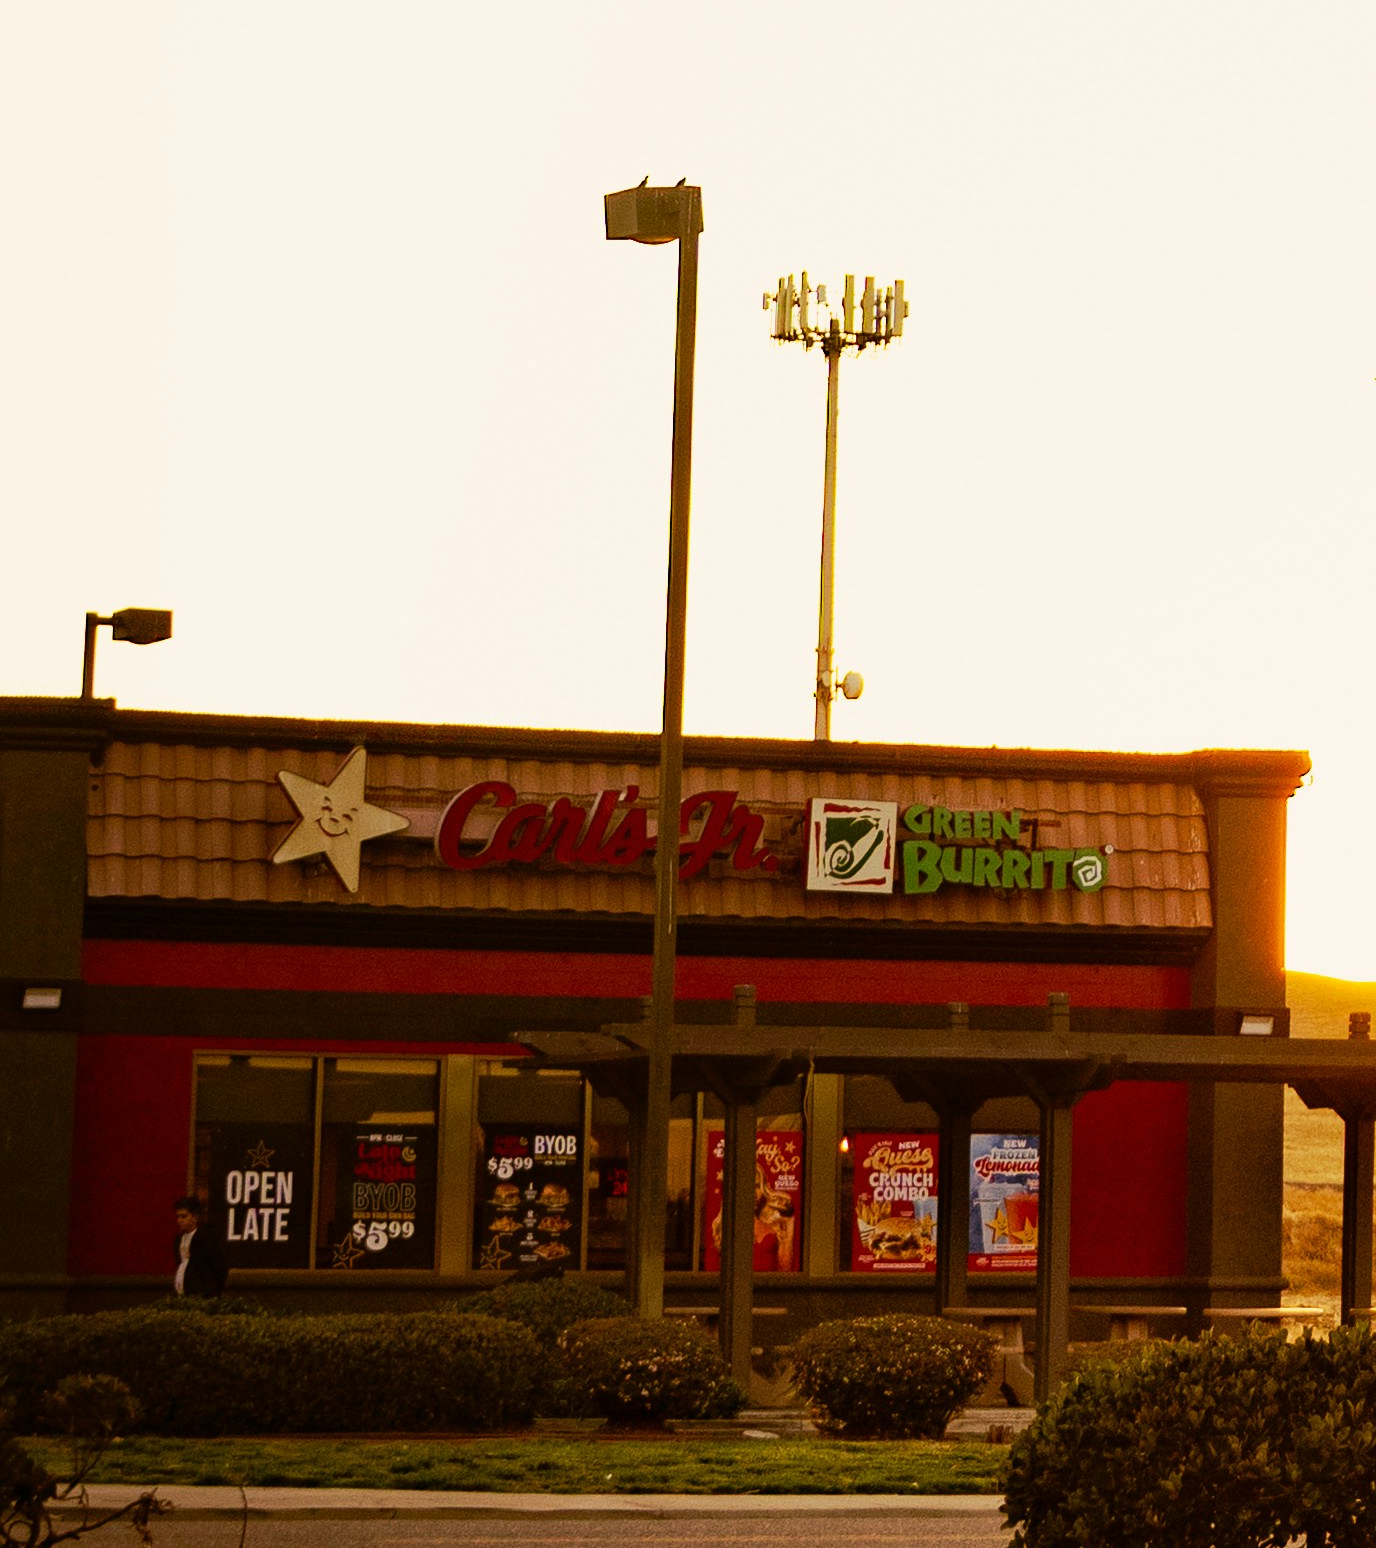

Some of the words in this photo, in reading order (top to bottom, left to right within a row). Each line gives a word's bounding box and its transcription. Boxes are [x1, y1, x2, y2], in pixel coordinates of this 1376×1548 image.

[437, 780, 658, 870] Carl's
[678, 790, 780, 881] Jr.
[904, 804, 1021, 840] GREEN
[903, 840, 1108, 894] BURRITO
[534, 1134, 577, 1155] BYOB
[898, 1141, 920, 1150] NEW
[1003, 1139, 1026, 1148] NEW
[770, 1155, 800, 1174] So?
[862, 1147, 934, 1175] Queso
[993, 1149, 1036, 1160] FROZEN
[974, 1156, 1040, 1177] Lemonad
[226, 1170, 293, 1205] OPEN
[869, 1172, 934, 1188] CRUNCH
[353, 1182, 417, 1211] BYOB
[873, 1186, 929, 1202] COMBO
[227, 1207, 290, 1242] LATE
